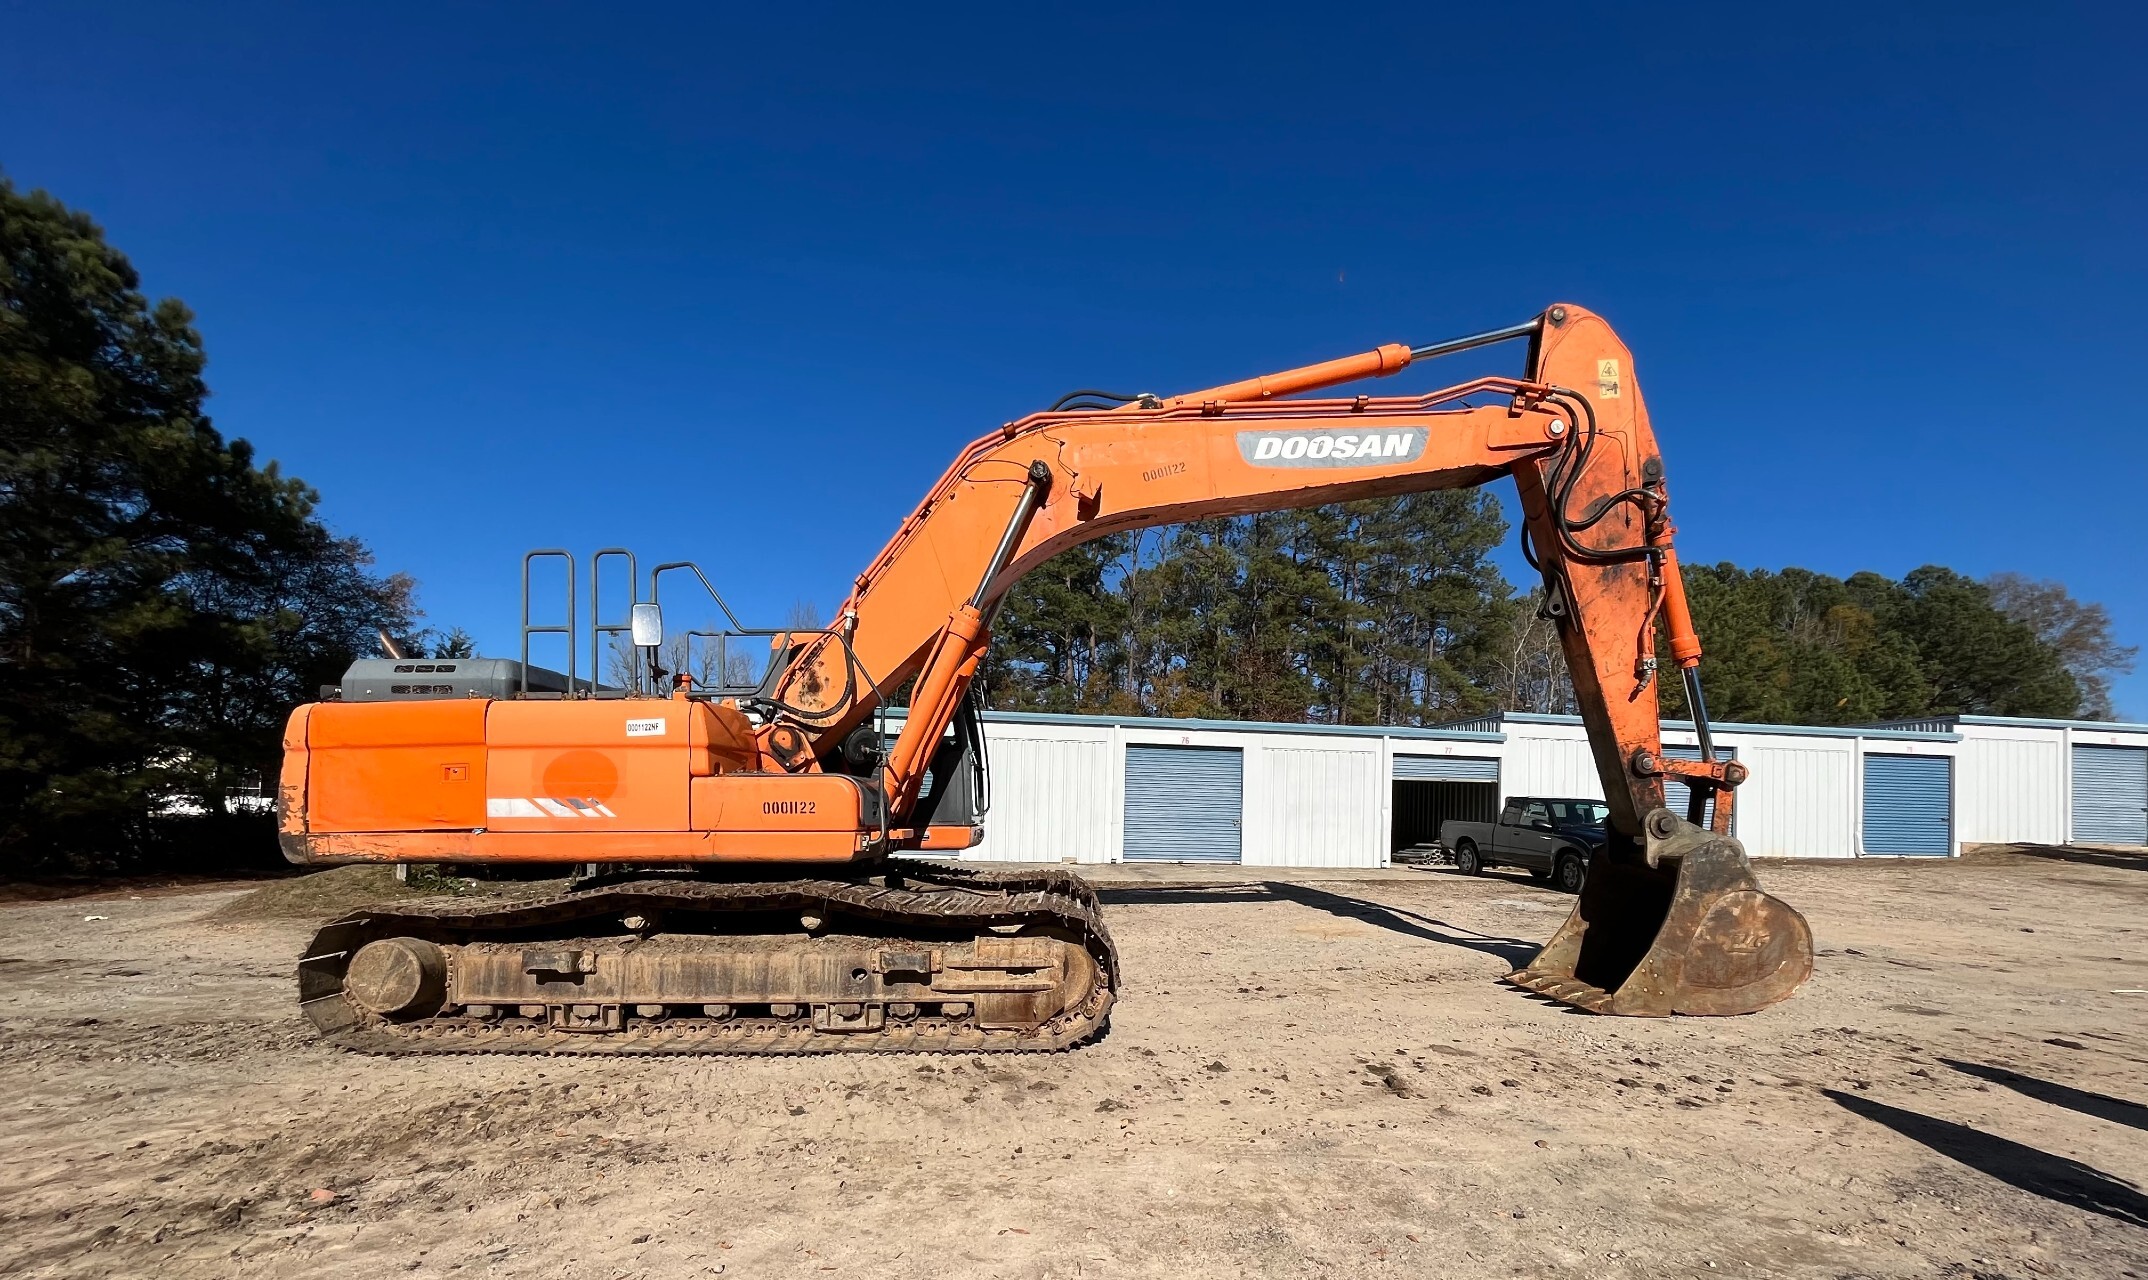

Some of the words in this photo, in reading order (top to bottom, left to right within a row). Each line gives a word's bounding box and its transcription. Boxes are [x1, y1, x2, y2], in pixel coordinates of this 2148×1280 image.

[1253, 433, 1414, 460] DOOSAN
[1142, 461, 1187, 482] 0001122
[763, 801, 816, 815] 0001122
